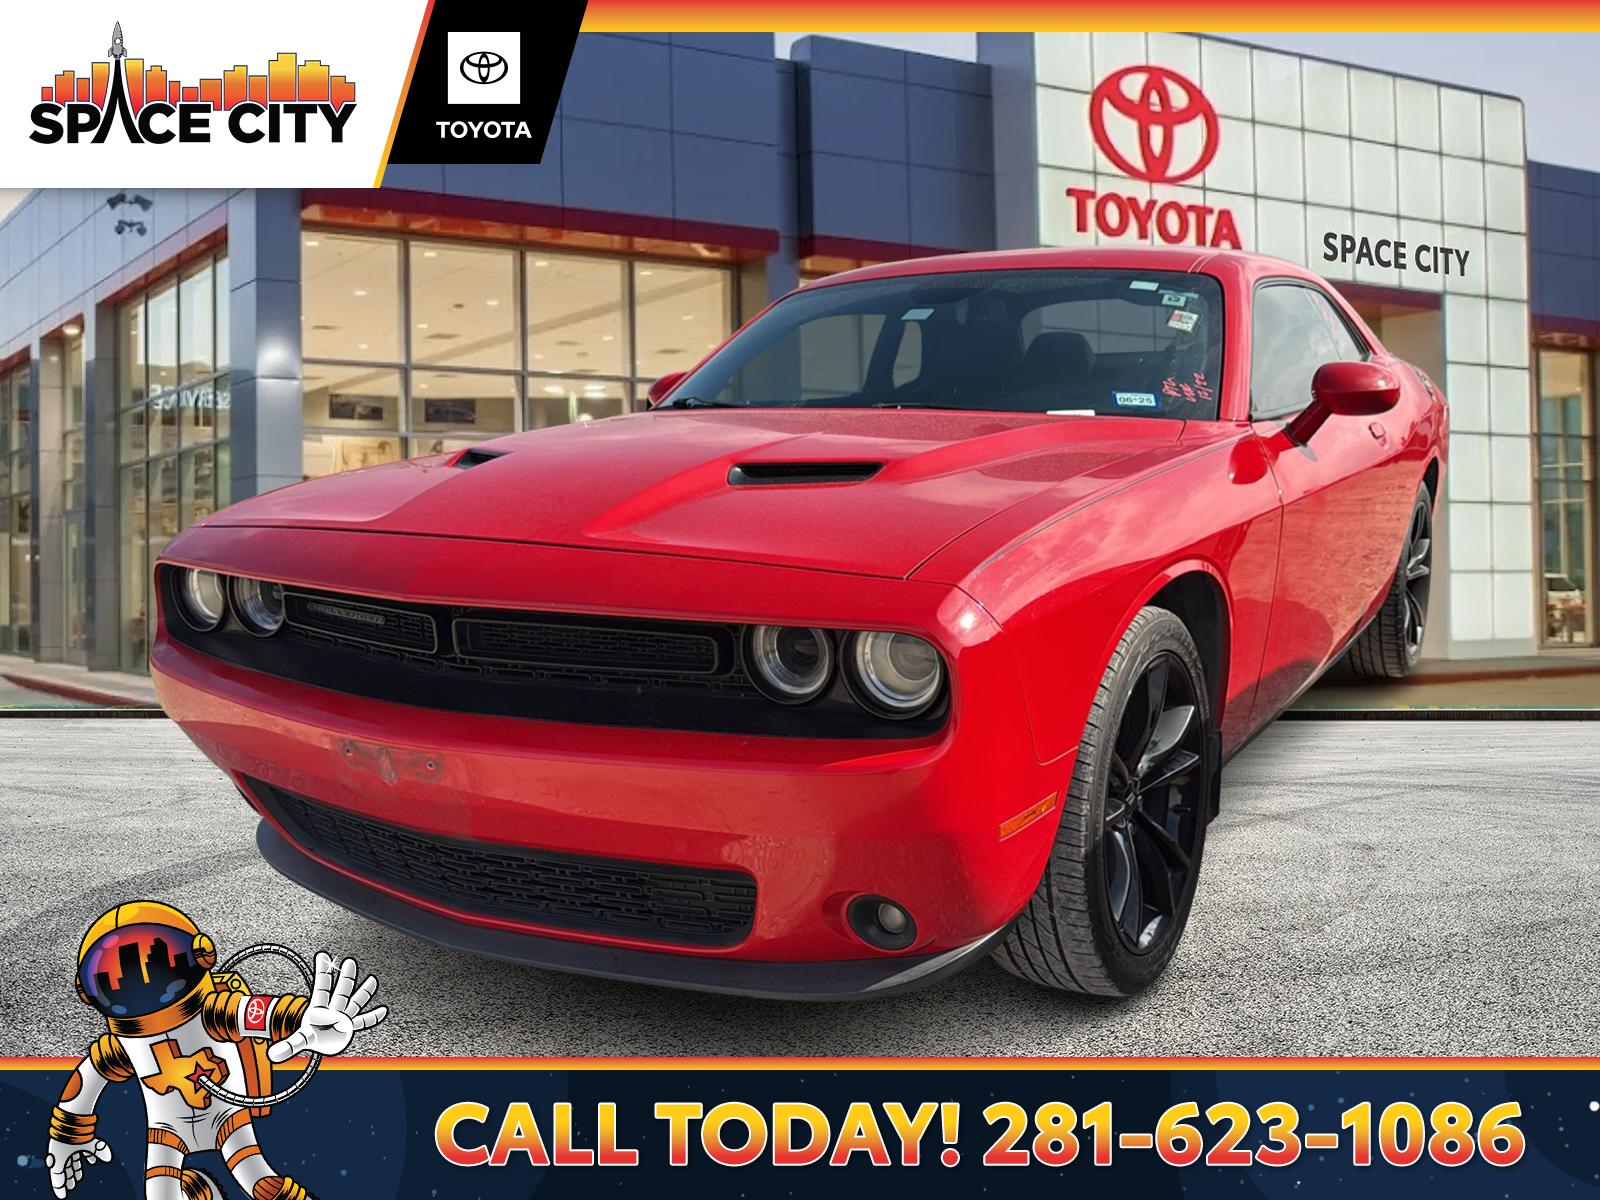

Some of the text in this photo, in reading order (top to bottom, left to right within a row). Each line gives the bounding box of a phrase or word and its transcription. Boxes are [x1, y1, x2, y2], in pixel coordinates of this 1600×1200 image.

[1066, 187, 1243, 249] TOYOTA
[1323, 232, 1470, 277] SPACE CITY
